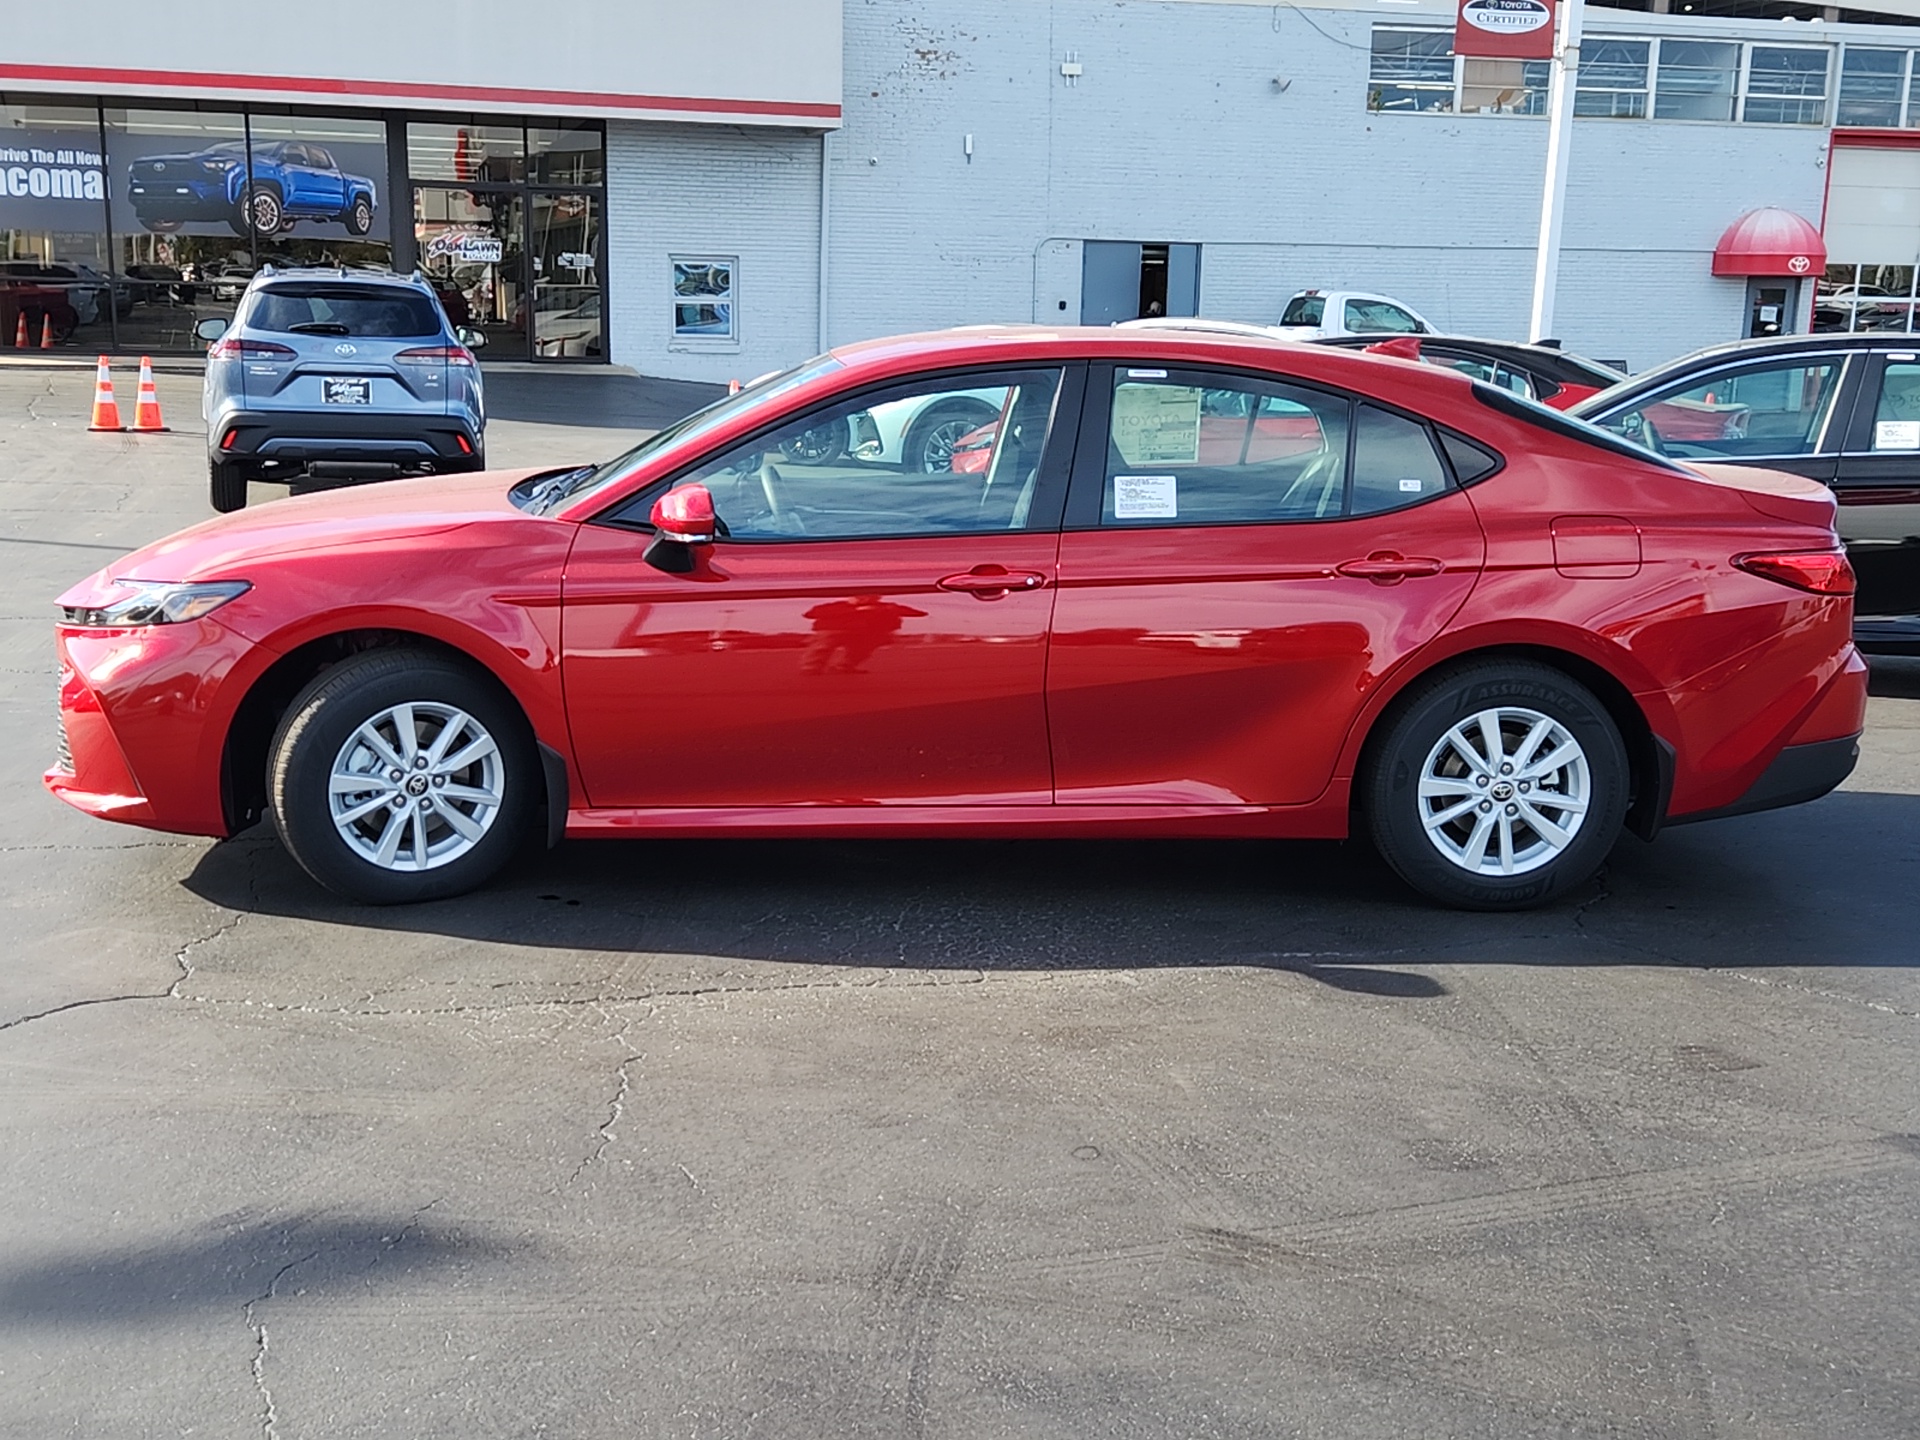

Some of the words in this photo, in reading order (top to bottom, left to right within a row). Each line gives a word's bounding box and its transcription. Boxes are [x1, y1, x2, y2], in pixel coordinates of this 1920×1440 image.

[1500, 1, 1532, 10] TOYOTA
[1476, 12, 1538, 25] CERTIFIED
[30, 148, 55, 164] The
[57, 149, 74, 165] All
[1479, 684, 1577, 712] ASSURANCE
